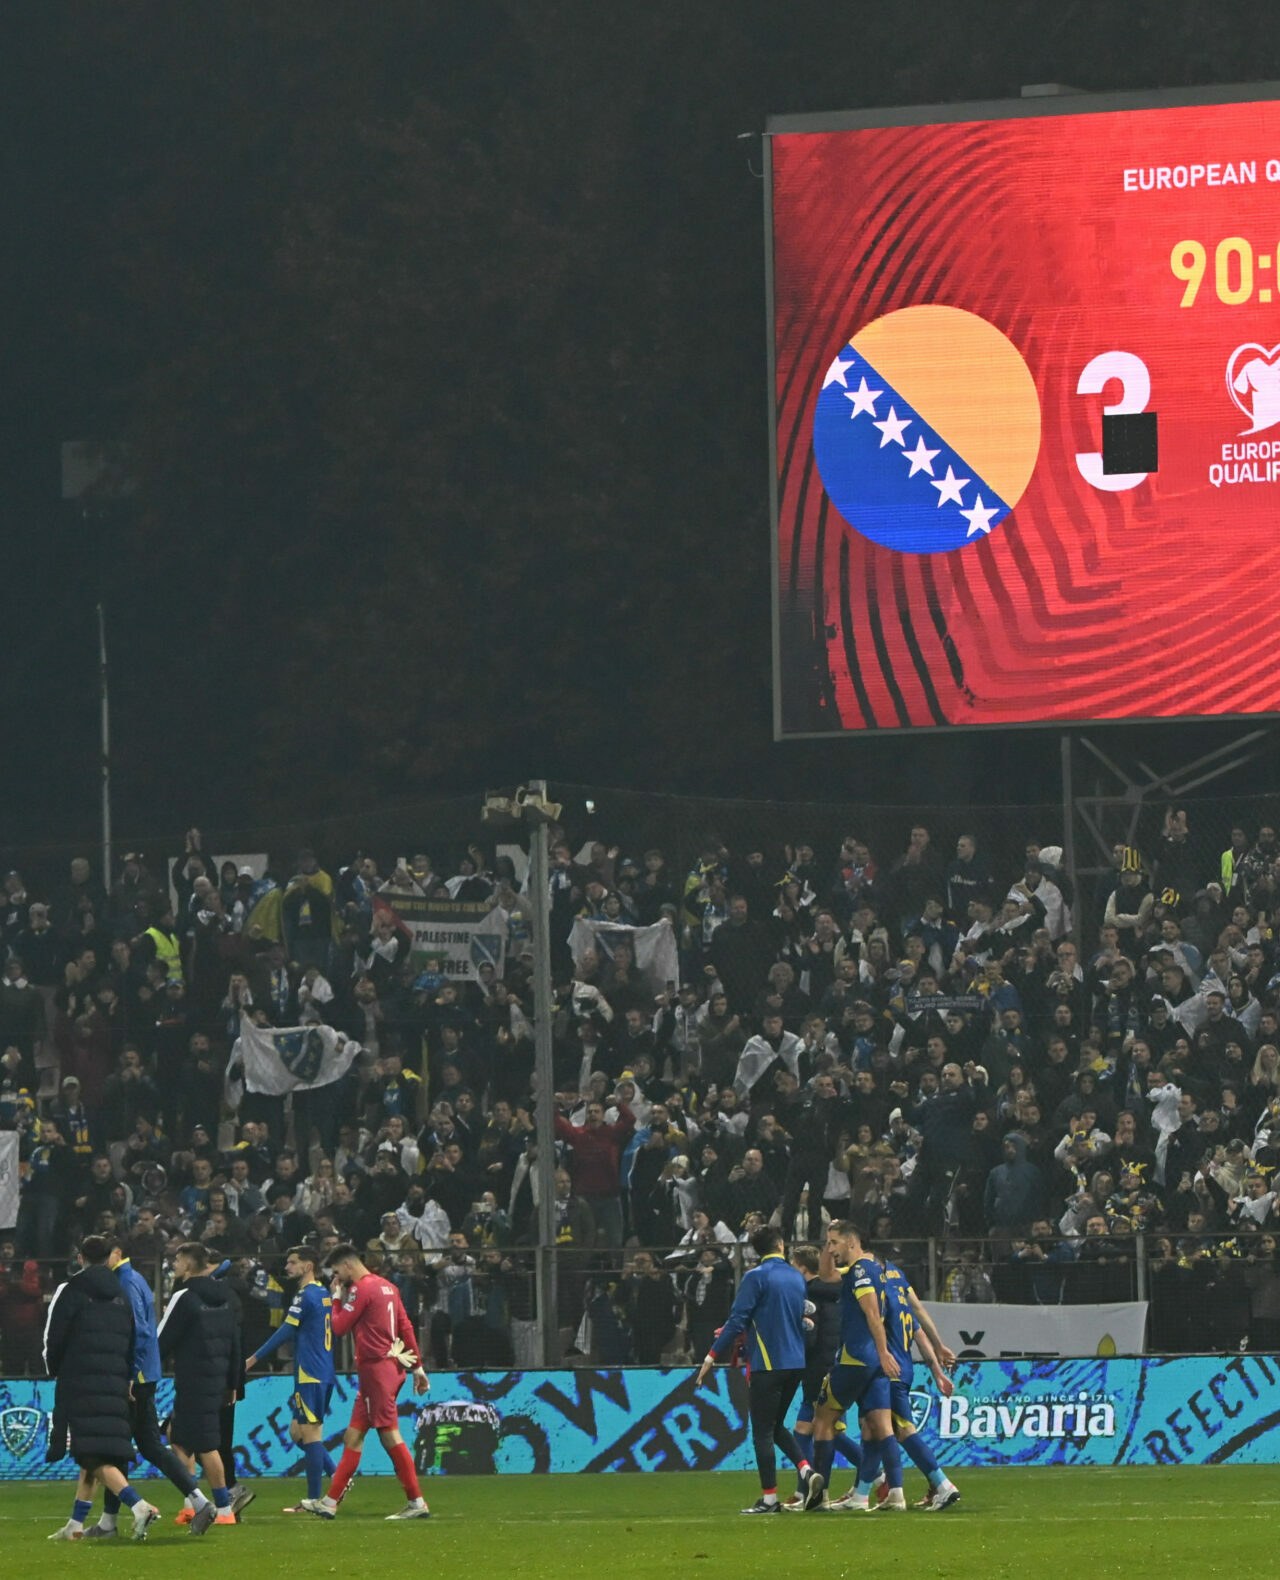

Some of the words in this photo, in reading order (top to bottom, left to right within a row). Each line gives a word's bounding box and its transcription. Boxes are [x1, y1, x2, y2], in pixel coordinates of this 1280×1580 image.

[1123, 161, 1256, 191] EUROPEAN
[1075, 351, 1151, 492] 3
[416, 930, 470, 944] PALESTINE
[443, 960, 469, 975] FREE
[324, 1312, 332, 1352] 8
[387, 1301, 396, 1341] 1
[974, 1395, 1031, 1403] HOLLAND
[1037, 1393, 1075, 1402] SINCE
[939, 1395, 1116, 1438] Bavaria
